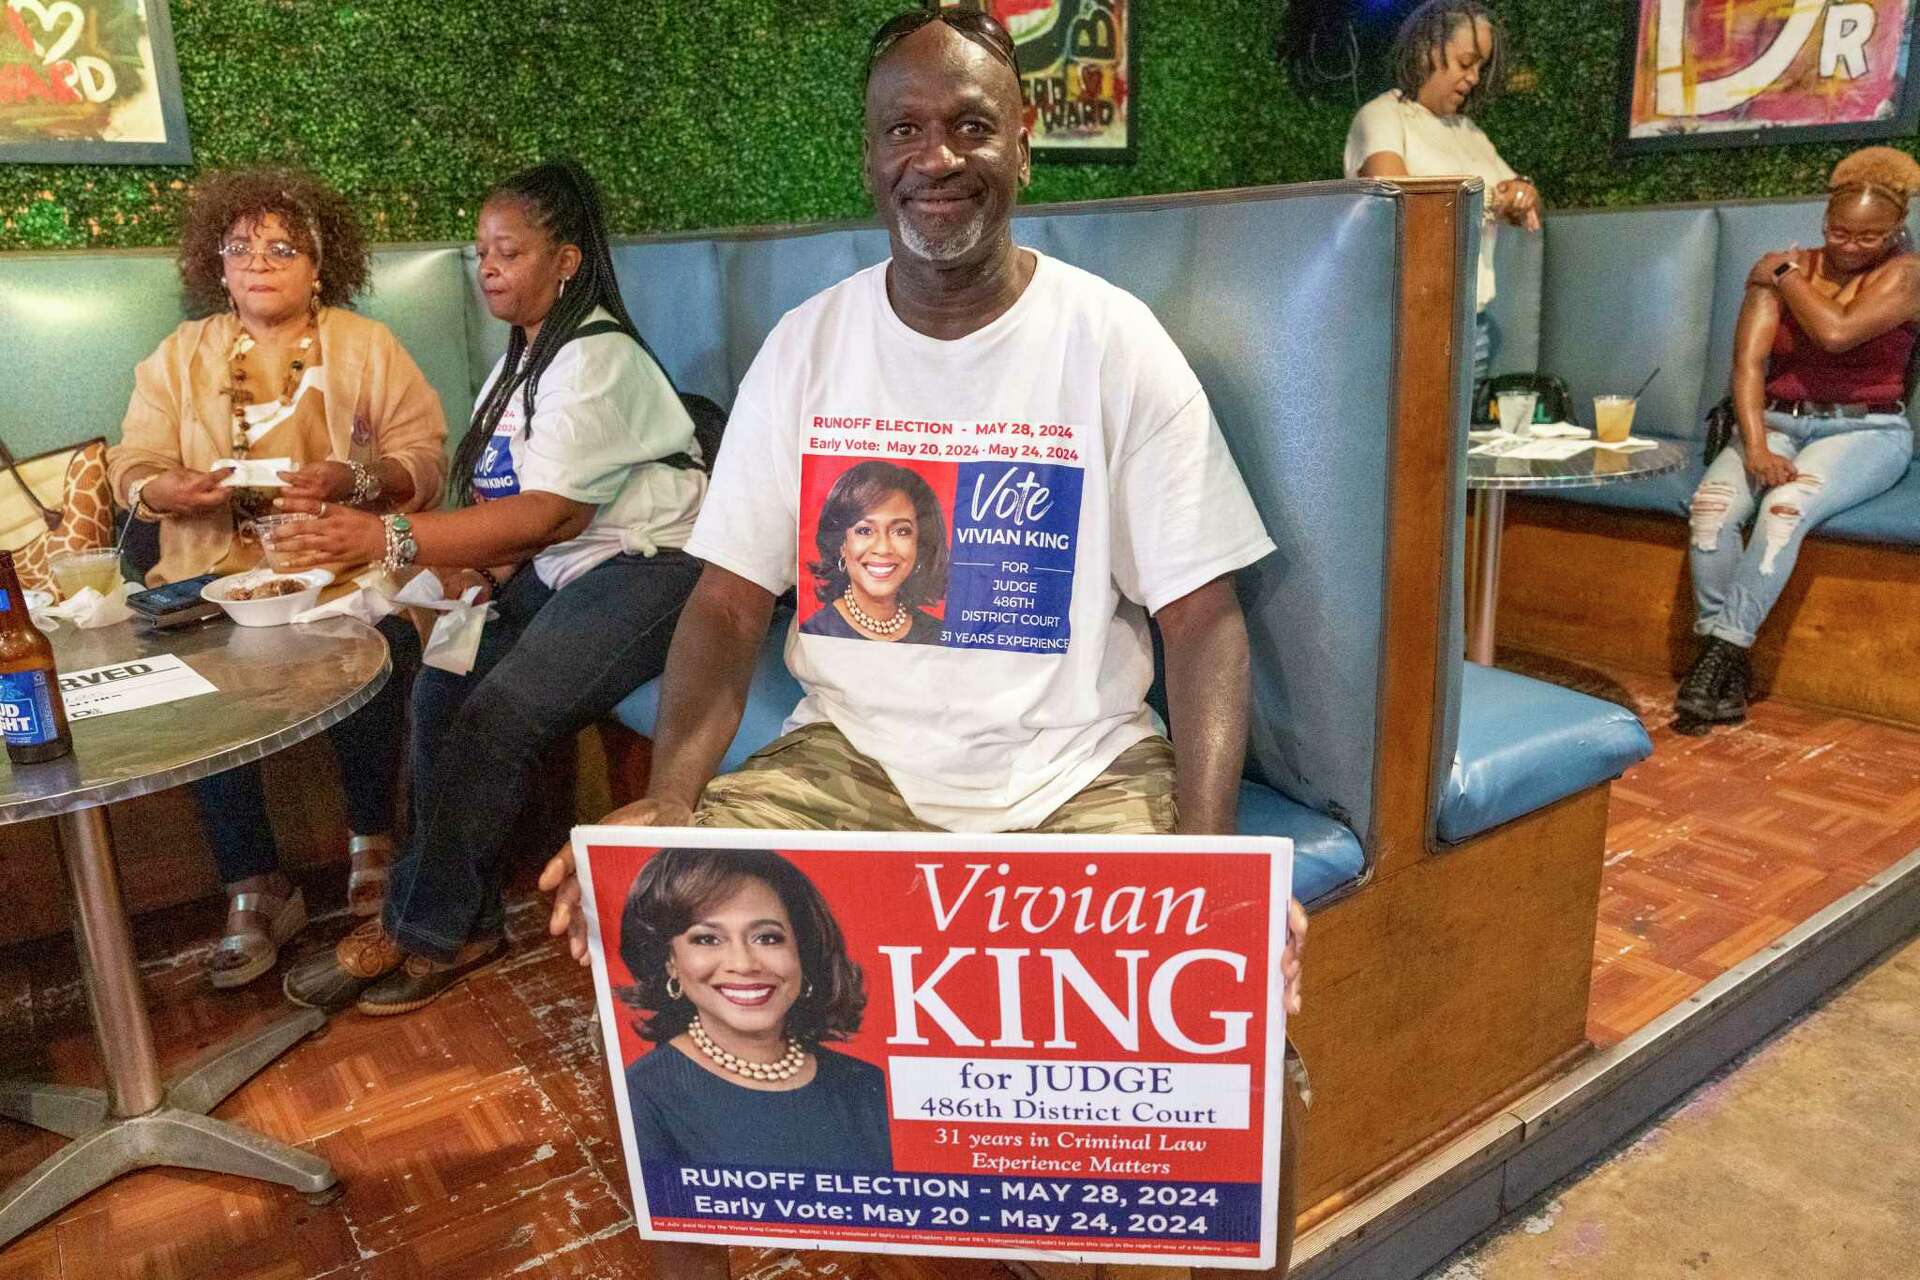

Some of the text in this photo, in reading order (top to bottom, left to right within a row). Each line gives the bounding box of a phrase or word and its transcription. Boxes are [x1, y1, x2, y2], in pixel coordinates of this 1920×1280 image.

[813, 416, 872, 429] RUNOFF
[875, 420, 953, 434] ELECTION
[976, 423, 1007, 435] MAY
[1011, 423, 1034, 438] 28,
[1039, 425, 1073, 439] 2024
[810, 437, 841, 452] Early
[845, 439, 880, 451] Vote:
[887, 441, 916, 456] May
[920, 444, 942, 456] 20,
[945, 445, 979, 456] 2024
[988, 444, 1018, 458] May
[1021, 445, 1043, 458] 24,
[1046, 447, 1079, 461] 2024
[488, 475, 514, 488] KING
[971, 467, 1054, 526] Vote
[957, 528, 1069, 550] VIVIAN KING
[1001, 561, 1029, 573] FOR
[992, 580, 1038, 593] JUDGE
[993, 596, 1035, 609] 486TH
[961, 610, 1061, 628] DISTRICT COURT
[941, 631, 1070, 649] 31 YEARS EXPERIENCE
[60, 664, 152, 690] RVED
[915, 863, 1208, 935] Vivian
[878, 945, 1253, 1054] KING
[960, 1062, 1173, 1096] for JUDGE
[921, 1097, 1217, 1124] 486th District Court
[934, 1129, 1208, 1152] 31 years in Criminal Law
[971, 1153, 1171, 1174] Experience Matters
[680, 1168, 805, 1190] RUNOFF
[816, 1174, 970, 1198] ELECTION
[1002, 1182, 1072, 1202] MAY
[1082, 1185, 1127, 1207] 28,
[1138, 1187, 1219, 1207] 2024
[694, 1195, 765, 1219] Early
[775, 1199, 853, 1220] Vote:
[863, 1203, 921, 1226] May
[931, 1207, 969, 1226] 20
[1001, 1210, 1060, 1232] May
[1071, 1212, 1117, 1234] 24,
[1128, 1215, 1208, 1234] 2024
